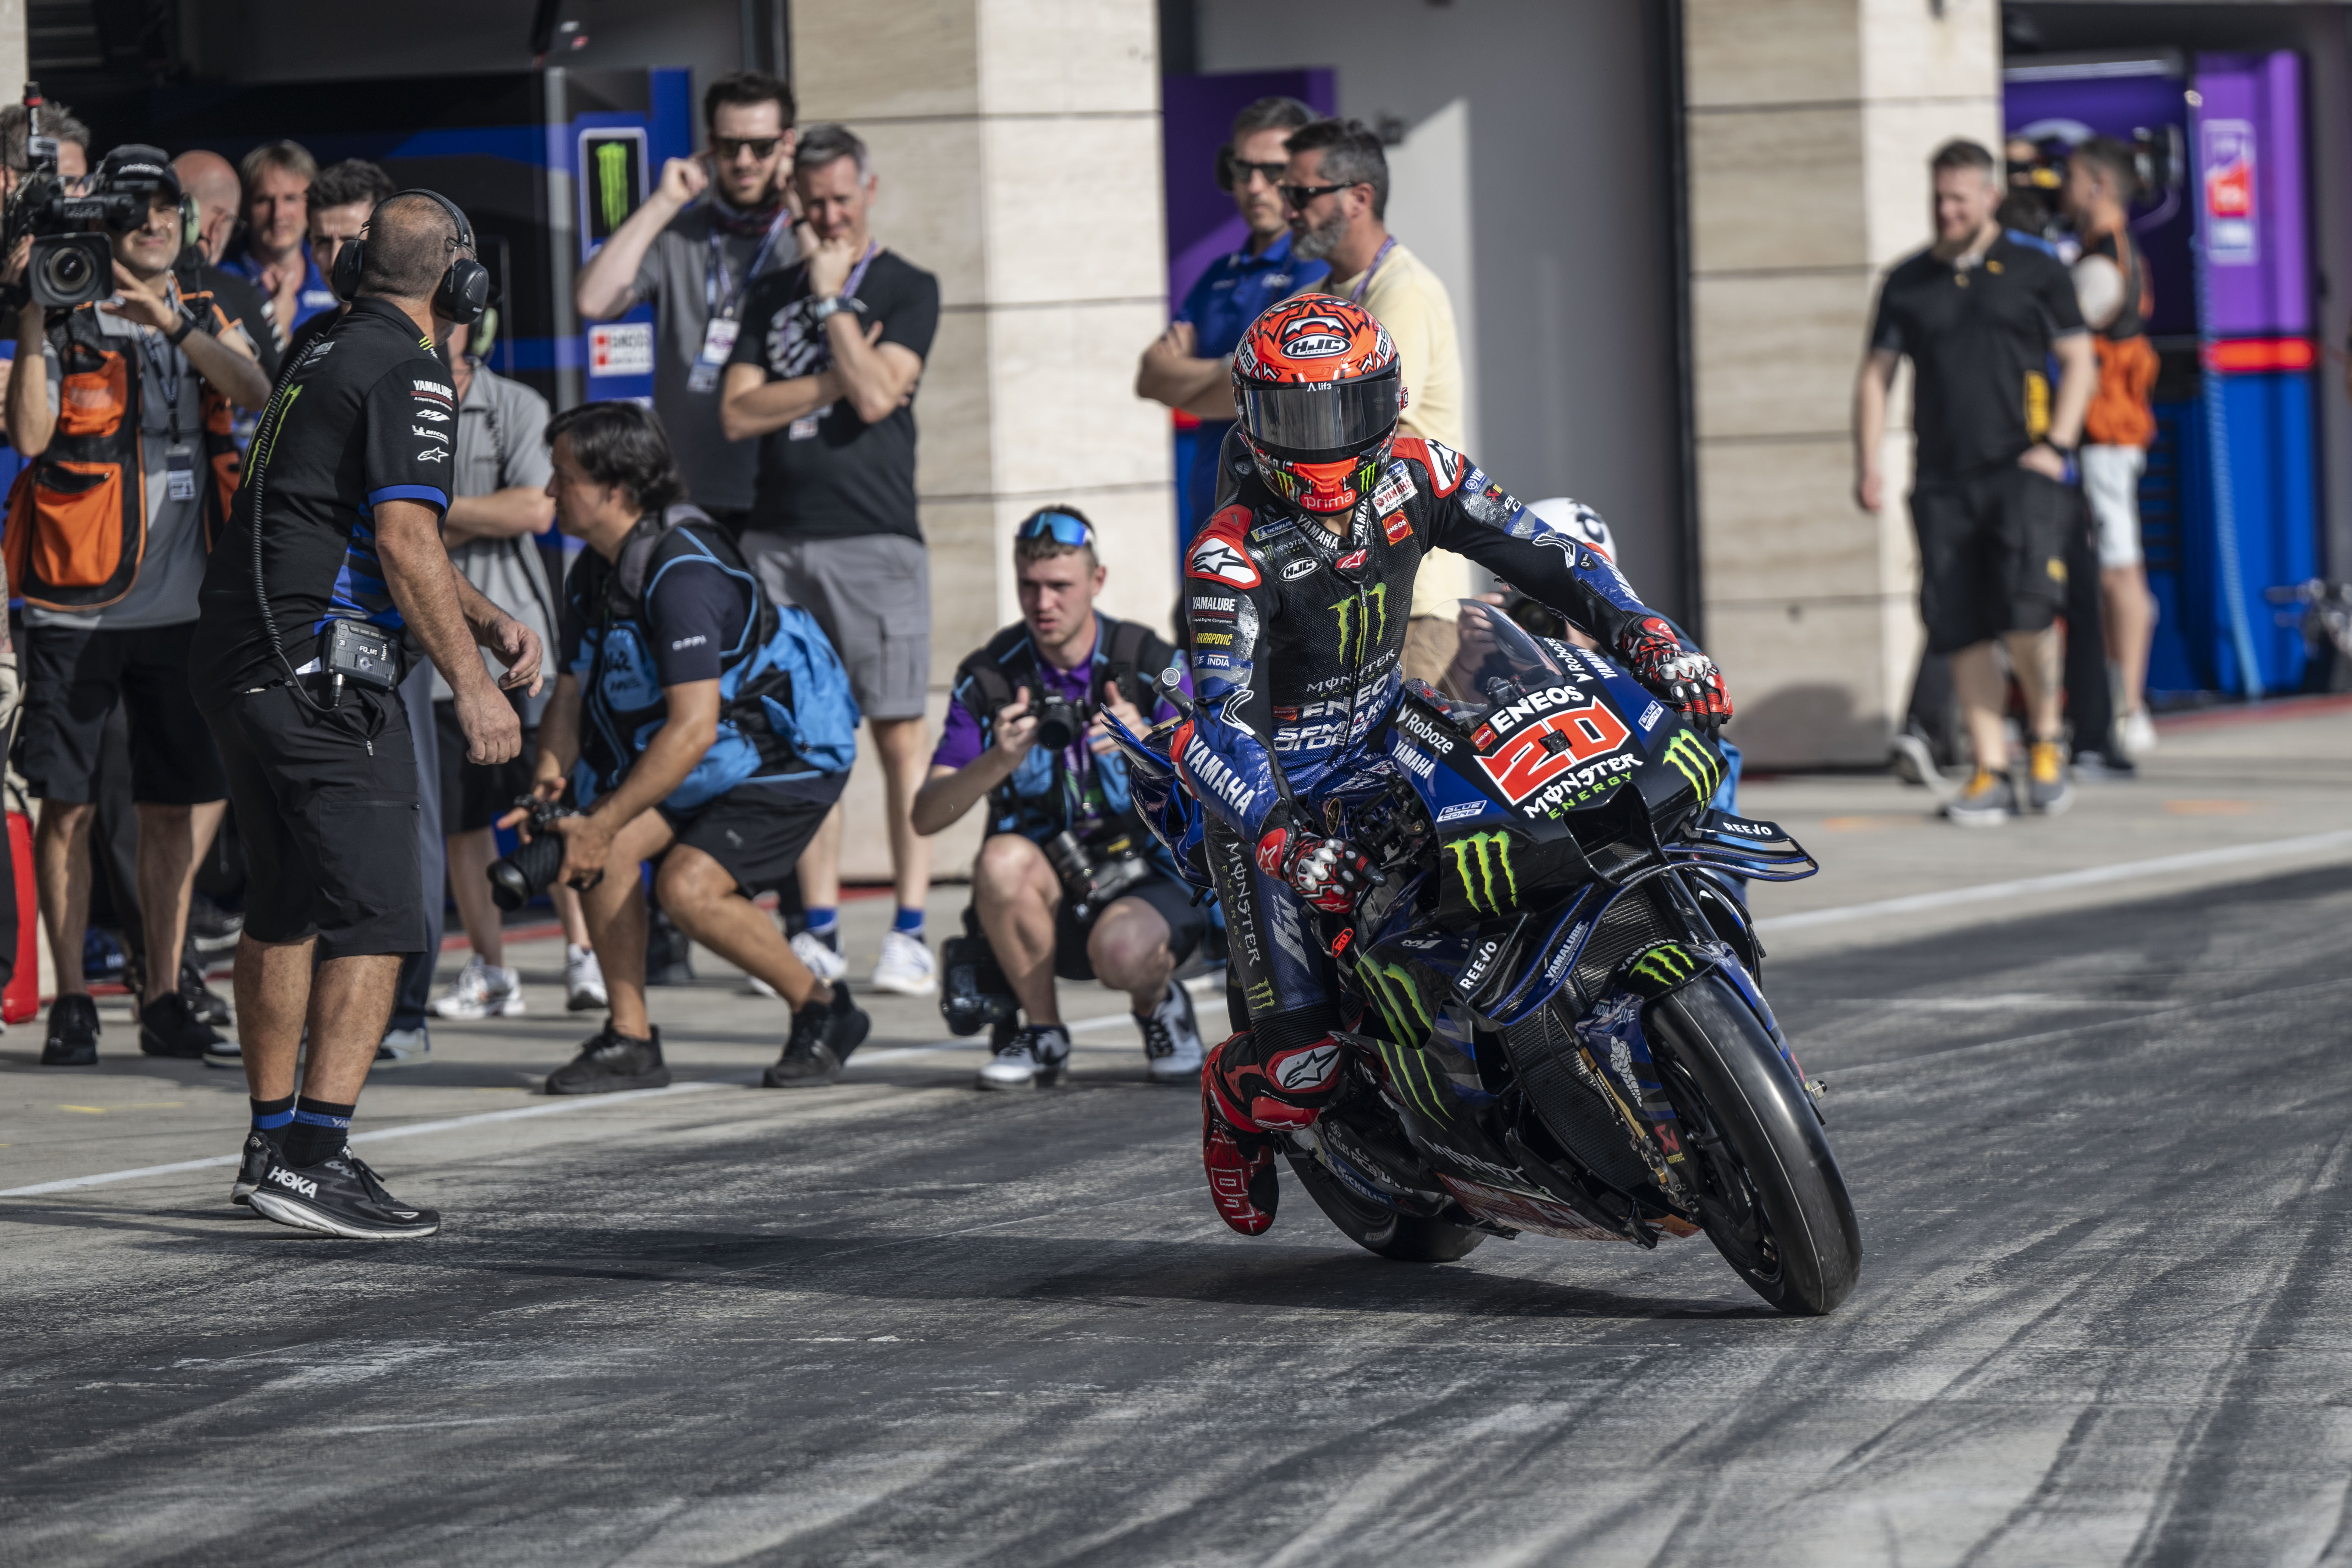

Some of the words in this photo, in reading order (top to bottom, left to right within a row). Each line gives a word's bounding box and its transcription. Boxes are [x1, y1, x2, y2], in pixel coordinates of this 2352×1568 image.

[1291, 339, 1341, 354] HJC
[413, 380, 453, 401] YAMALUBE
[1304, 492, 1352, 509] prima
[1383, 478, 1412, 503] YAMAHA
[1297, 514, 1339, 550] YAMAHA
[1386, 519, 1406, 535] ENEOS
[1285, 559, 1313, 578] HJC
[1193, 596, 1235, 612] YAMALUBE
[1207, 657, 1229, 667] INDIA
[1543, 638, 1585, 672] Roboze
[1489, 685, 1585, 734] ENEOS
[1640, 703, 1656, 724] BLUE
[1646, 709, 1661, 727] CORE
[1405, 713, 1454, 755] Roboze
[1475, 729, 1491, 745] ENEOS
[1391, 740, 1435, 779] YAMAHA
[1473, 695, 1632, 806] 20
[1183, 734, 1255, 817] YAMAHA
[1522, 753, 1643, 819] MONSTER
[1444, 802, 1481, 814] BLUE
[1548, 771, 1632, 820] ENERGY
[1441, 809, 1478, 821] CORE
[1222, 865, 1242, 949] ENERGY
[1225, 842, 1260, 967] MONSTER
[1334, 933, 1349, 951] 20
[1544, 922, 1585, 979] YAMALUBE
[1618, 939, 1679, 971] YAMAHA
[1592, 1004, 1610, 1017] INDIA
[1328, 1132, 1350, 1156] GILLES
[267, 1166, 318, 1198] HOKA
[1338, 1165, 1388, 1204] MICHELIN
